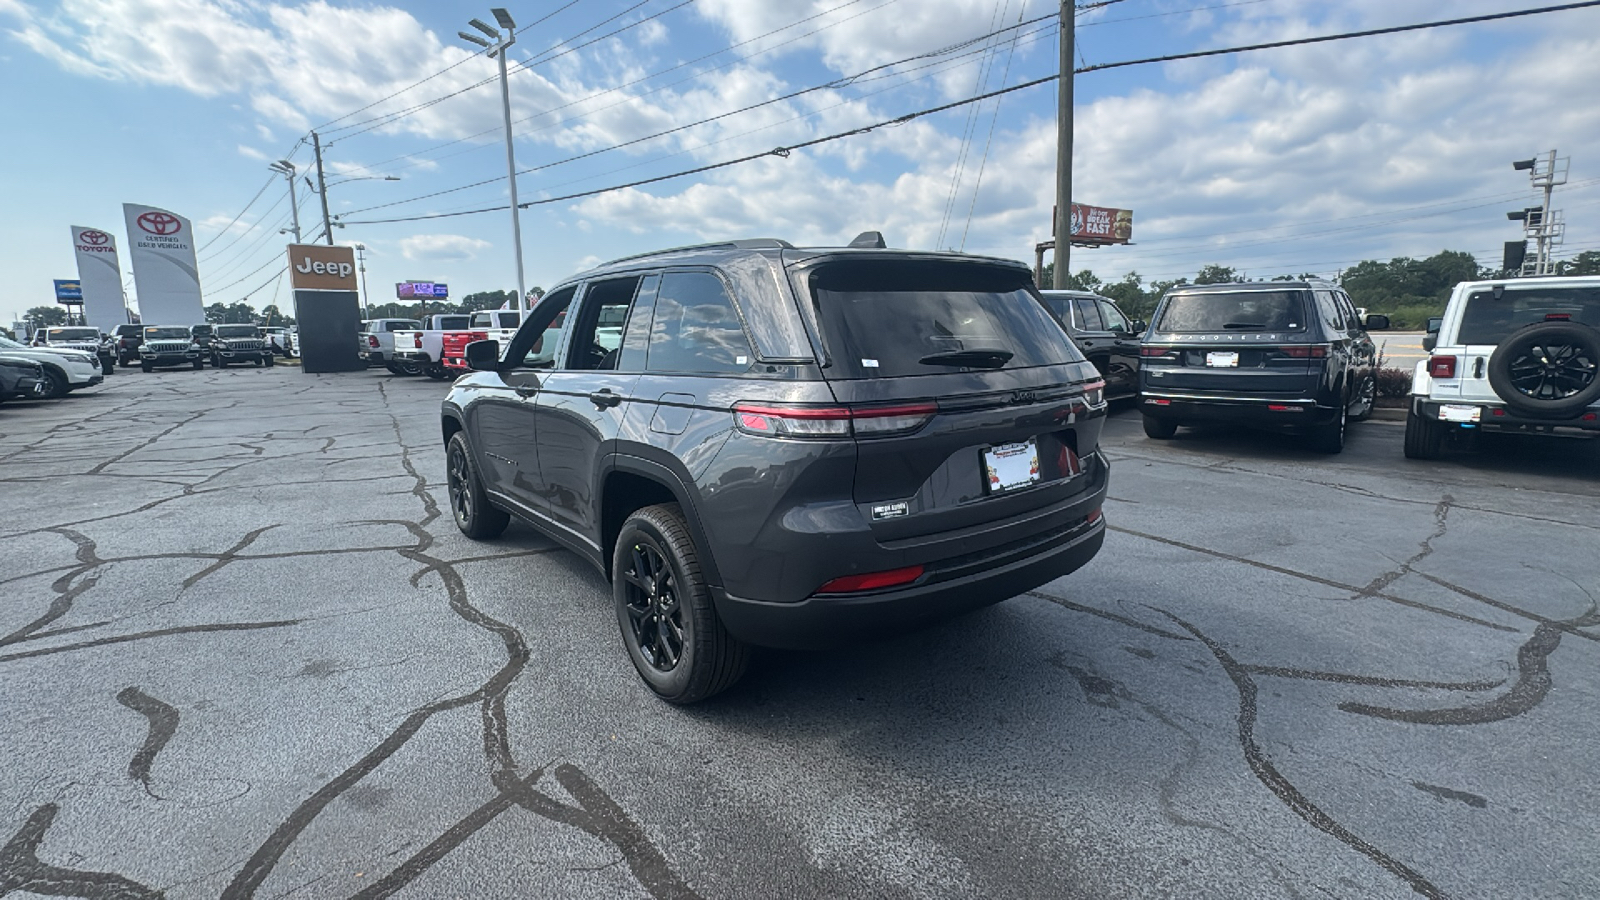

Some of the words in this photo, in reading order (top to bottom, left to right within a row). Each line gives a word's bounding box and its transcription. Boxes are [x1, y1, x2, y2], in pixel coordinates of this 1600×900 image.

[1086, 215, 1110, 224] BREAK
[1086, 222, 1110, 234] FAST
[146, 235, 179, 243] CERTIFIED
[76, 244, 115, 253] TOYOTA
[156, 242, 188, 250] VEHICLES
[296, 256, 353, 278] Jeep
[1175, 333, 1276, 341] WAGONEER
